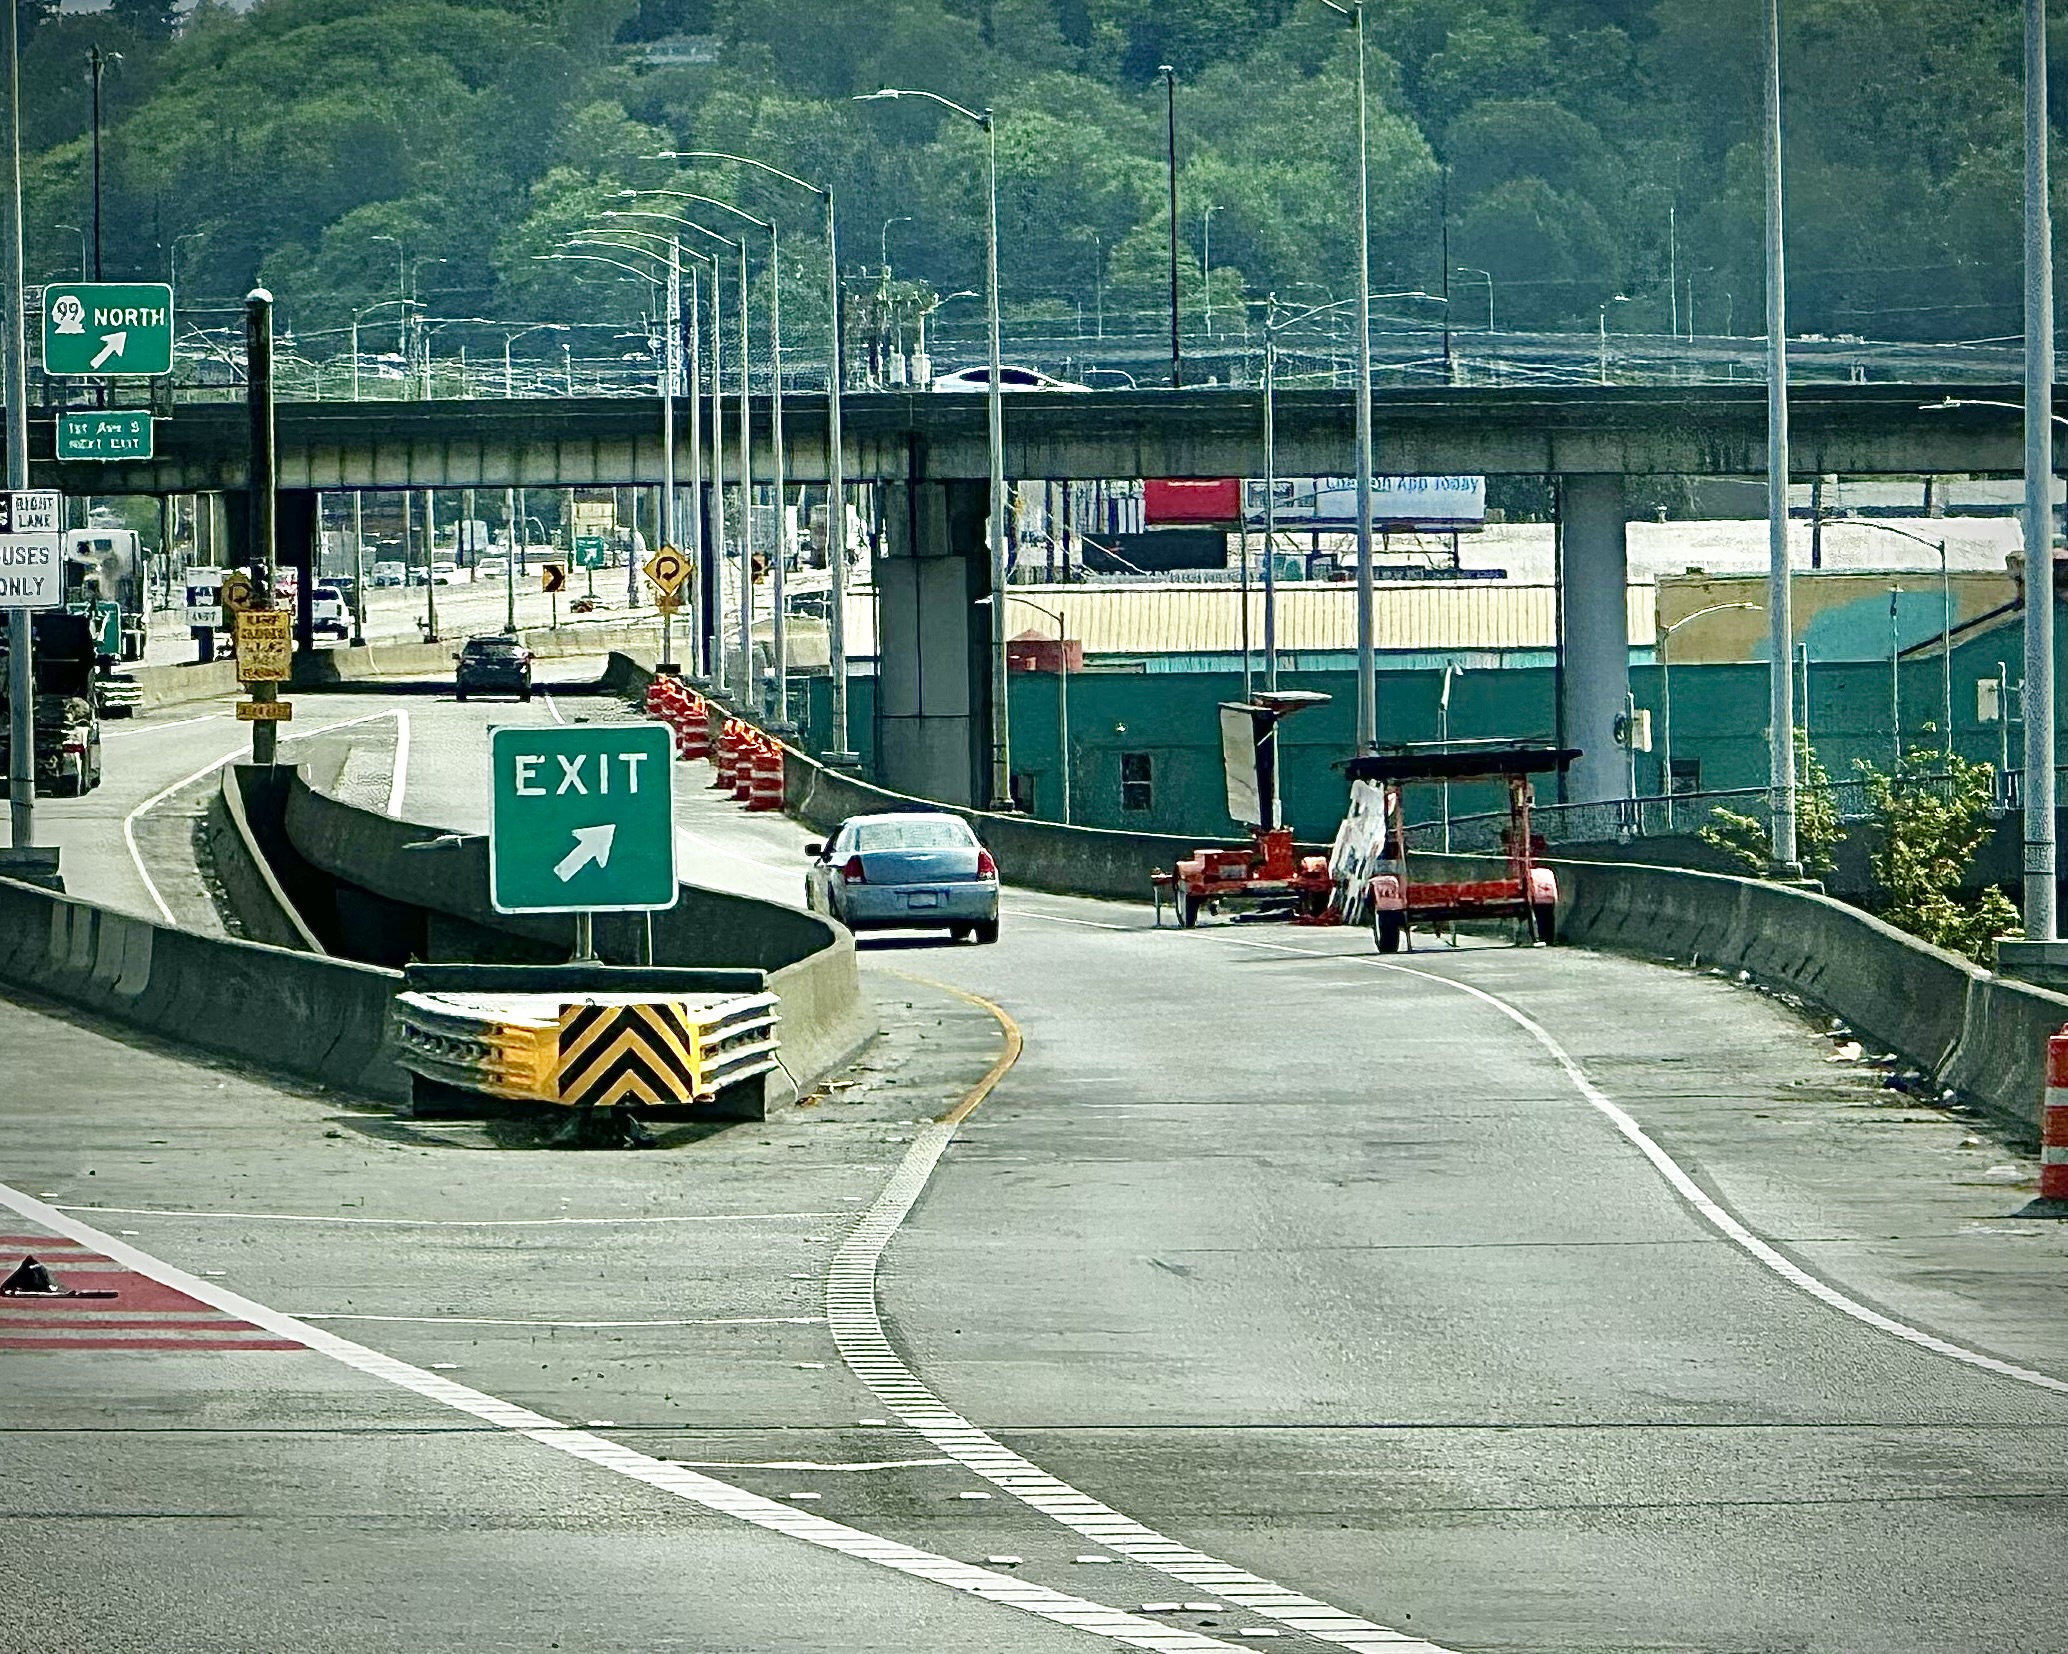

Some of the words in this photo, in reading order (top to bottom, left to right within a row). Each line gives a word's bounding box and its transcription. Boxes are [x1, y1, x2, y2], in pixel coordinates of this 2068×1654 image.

[57, 301, 79, 321] 99
[94, 307, 165, 327] NORTH
[16, 496, 53, 511] RIGHT
[18, 514, 51, 528] LANE
[0, 546, 49, 566] USES
[0, 577, 45, 596] ONLY
[515, 752, 648, 796] EXIT
